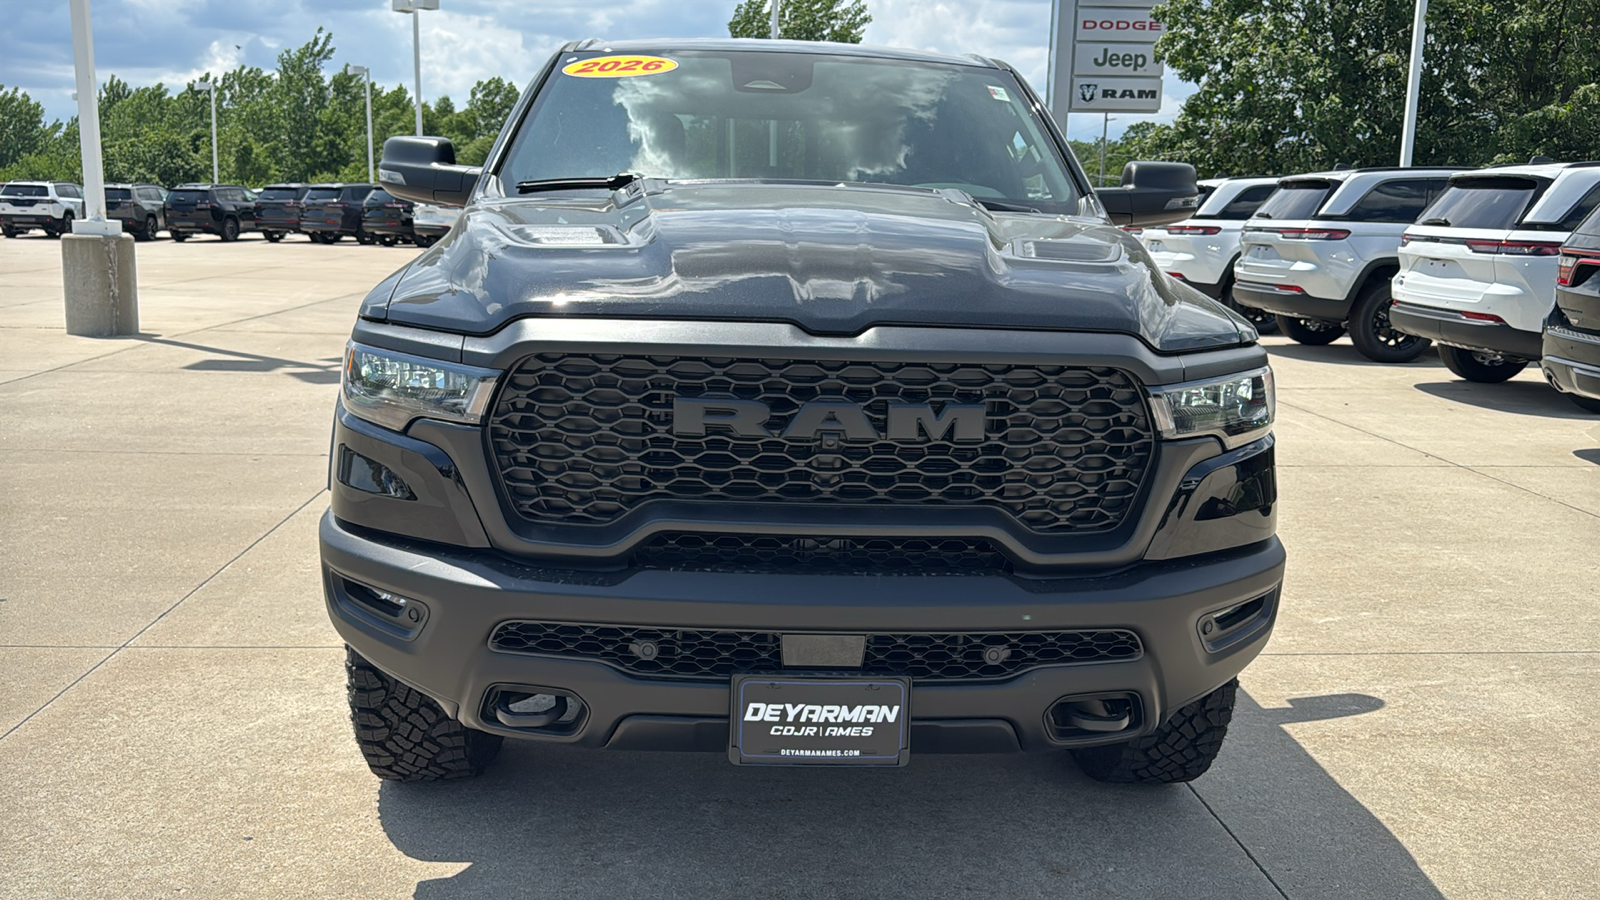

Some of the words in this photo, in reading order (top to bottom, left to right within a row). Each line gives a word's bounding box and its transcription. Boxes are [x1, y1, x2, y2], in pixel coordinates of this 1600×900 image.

[1082, 20, 1162, 31] DODGE
[1093, 48, 1147, 71] Jeep
[573, 60, 666, 74] 2026
[1101, 89, 1157, 99] RAM
[673, 397, 986, 441] RAM
[743, 702, 900, 723] DEYARMAN
[780, 748, 860, 757] DEYARMANAMES.COM
